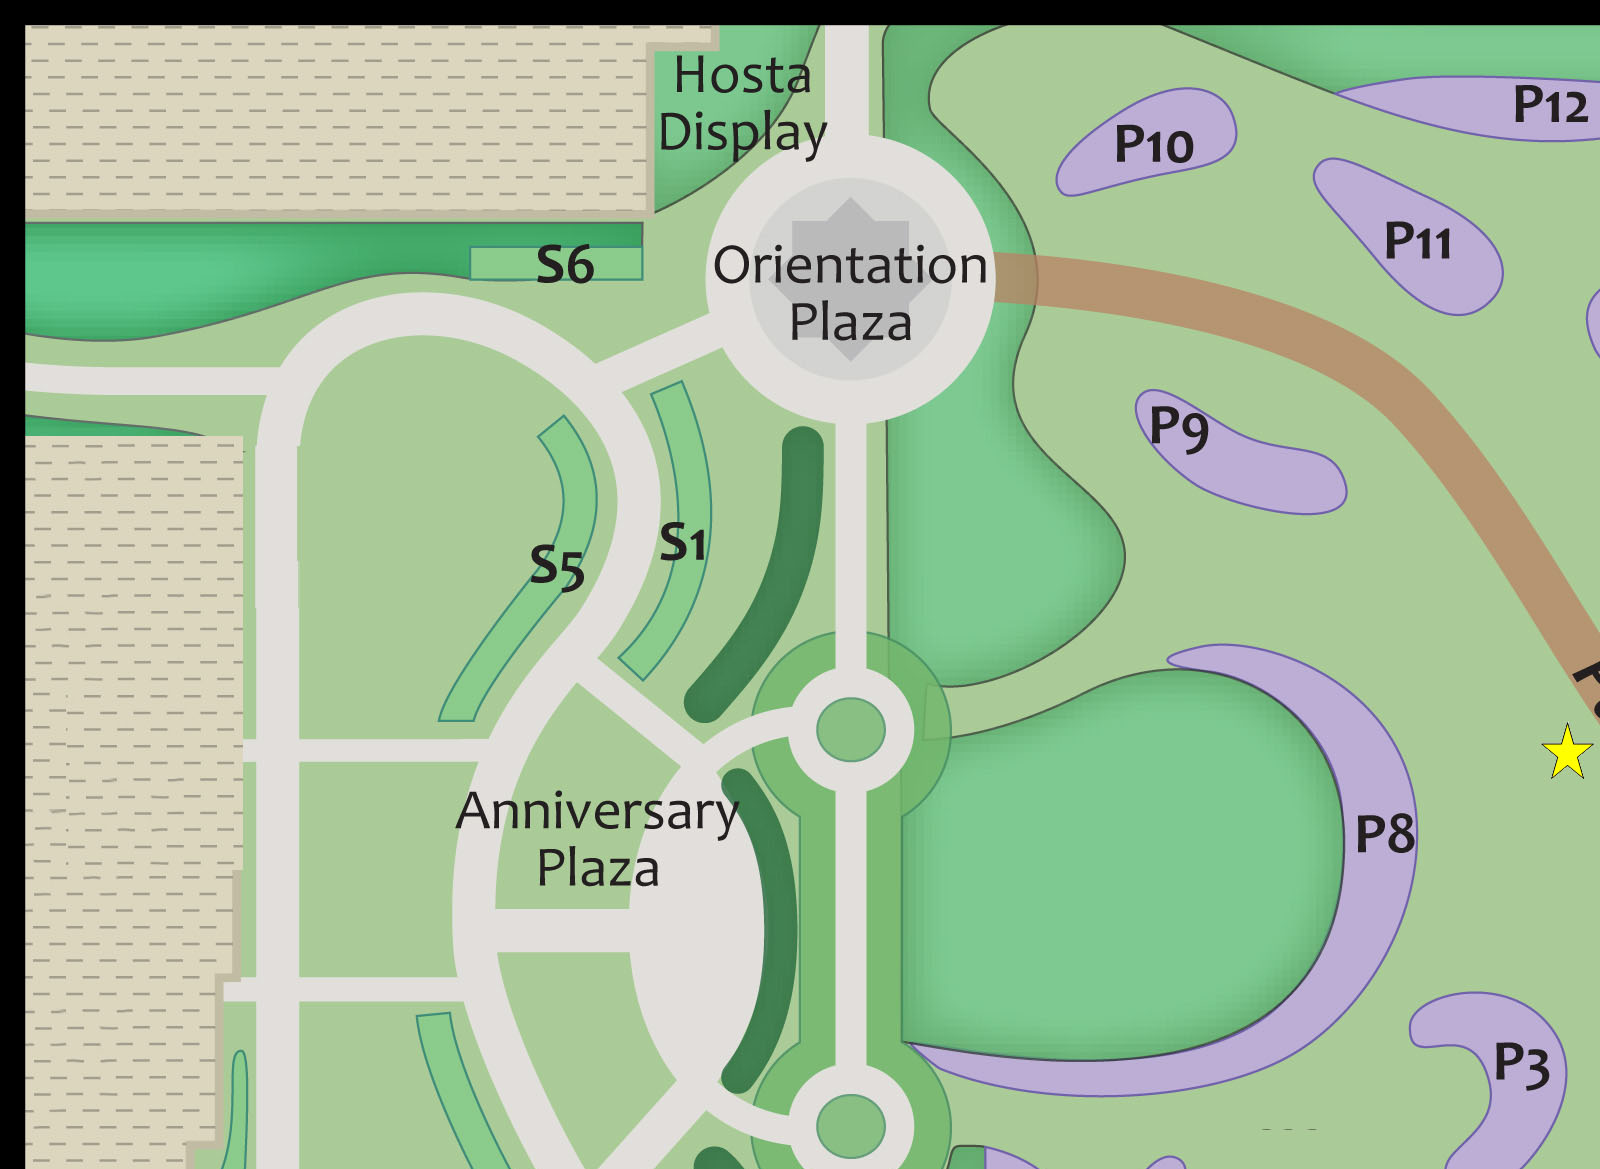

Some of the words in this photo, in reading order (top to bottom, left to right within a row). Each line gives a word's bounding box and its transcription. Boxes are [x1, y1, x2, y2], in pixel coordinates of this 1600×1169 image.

[675, 55, 812, 97] Hosta
[1514, 84, 1590, 123] P12
[659, 107, 829, 164] Display
[1115, 124, 1195, 164] P10
[1385, 221, 1451, 259] P11
[536, 243, 596, 284] S6
[713, 244, 987, 284] Orientation
[791, 299, 912, 341] Plaza
[1150, 405, 1210, 455] P9
[659, 521, 706, 561] S1
[529, 544, 586, 593] S5
[454, 790, 741, 842] Anniversary
[1356, 812, 1416, 854] P8
[538, 845, 659, 887] Plaza
[1495, 1042, 1551, 1091] P3
